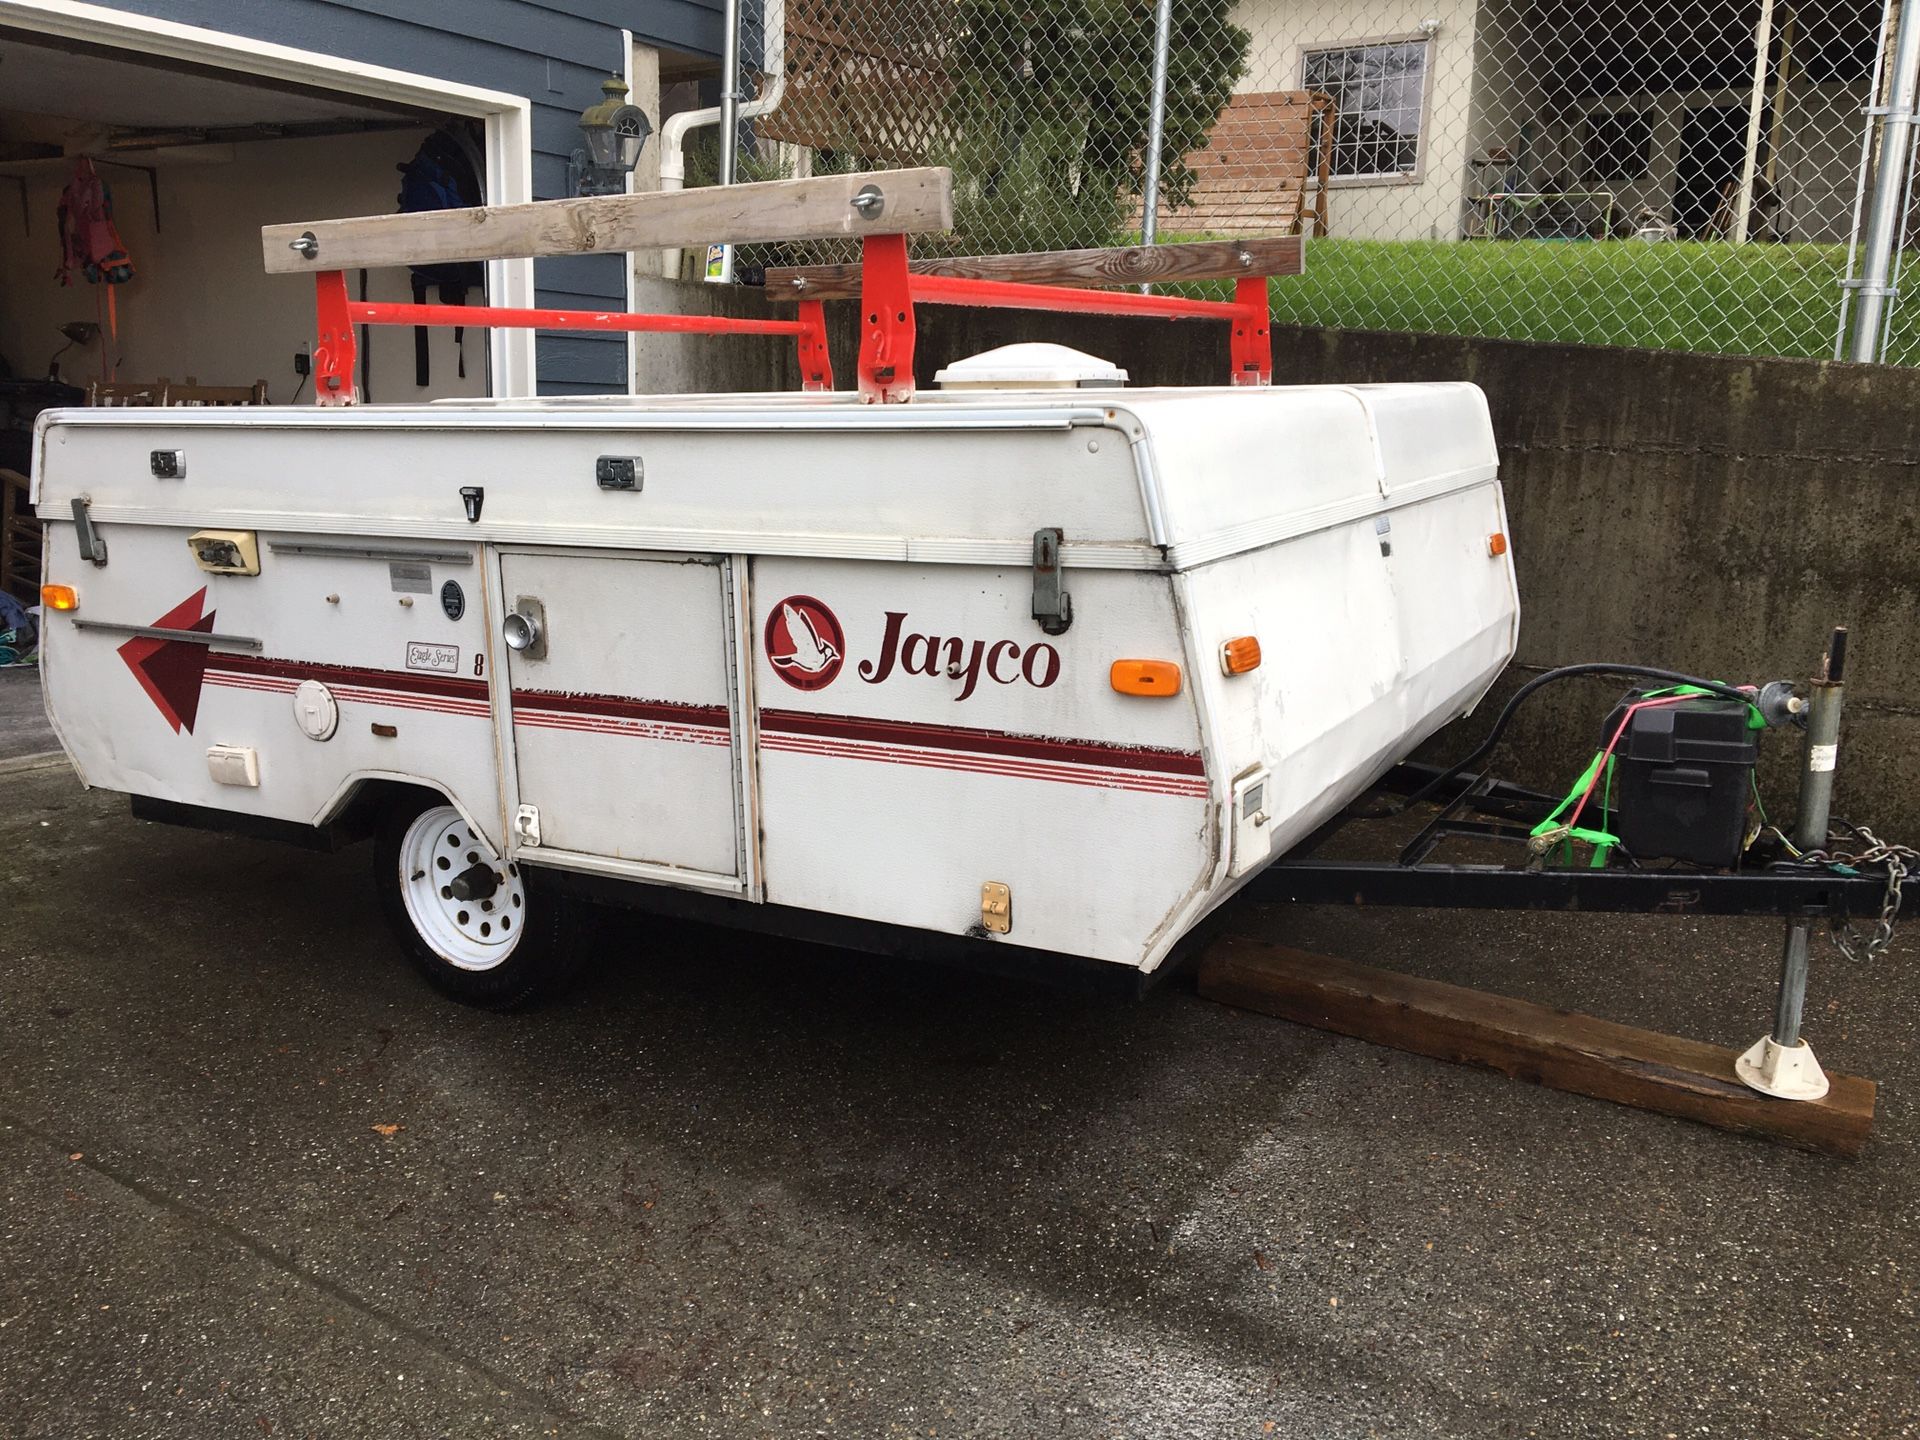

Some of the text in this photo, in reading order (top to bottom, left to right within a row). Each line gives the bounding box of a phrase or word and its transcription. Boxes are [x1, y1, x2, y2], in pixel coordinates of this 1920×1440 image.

[410, 647, 456, 666] Eagle Series
[474, 653, 484, 676] 8
[858, 611, 1061, 701] Jayco
